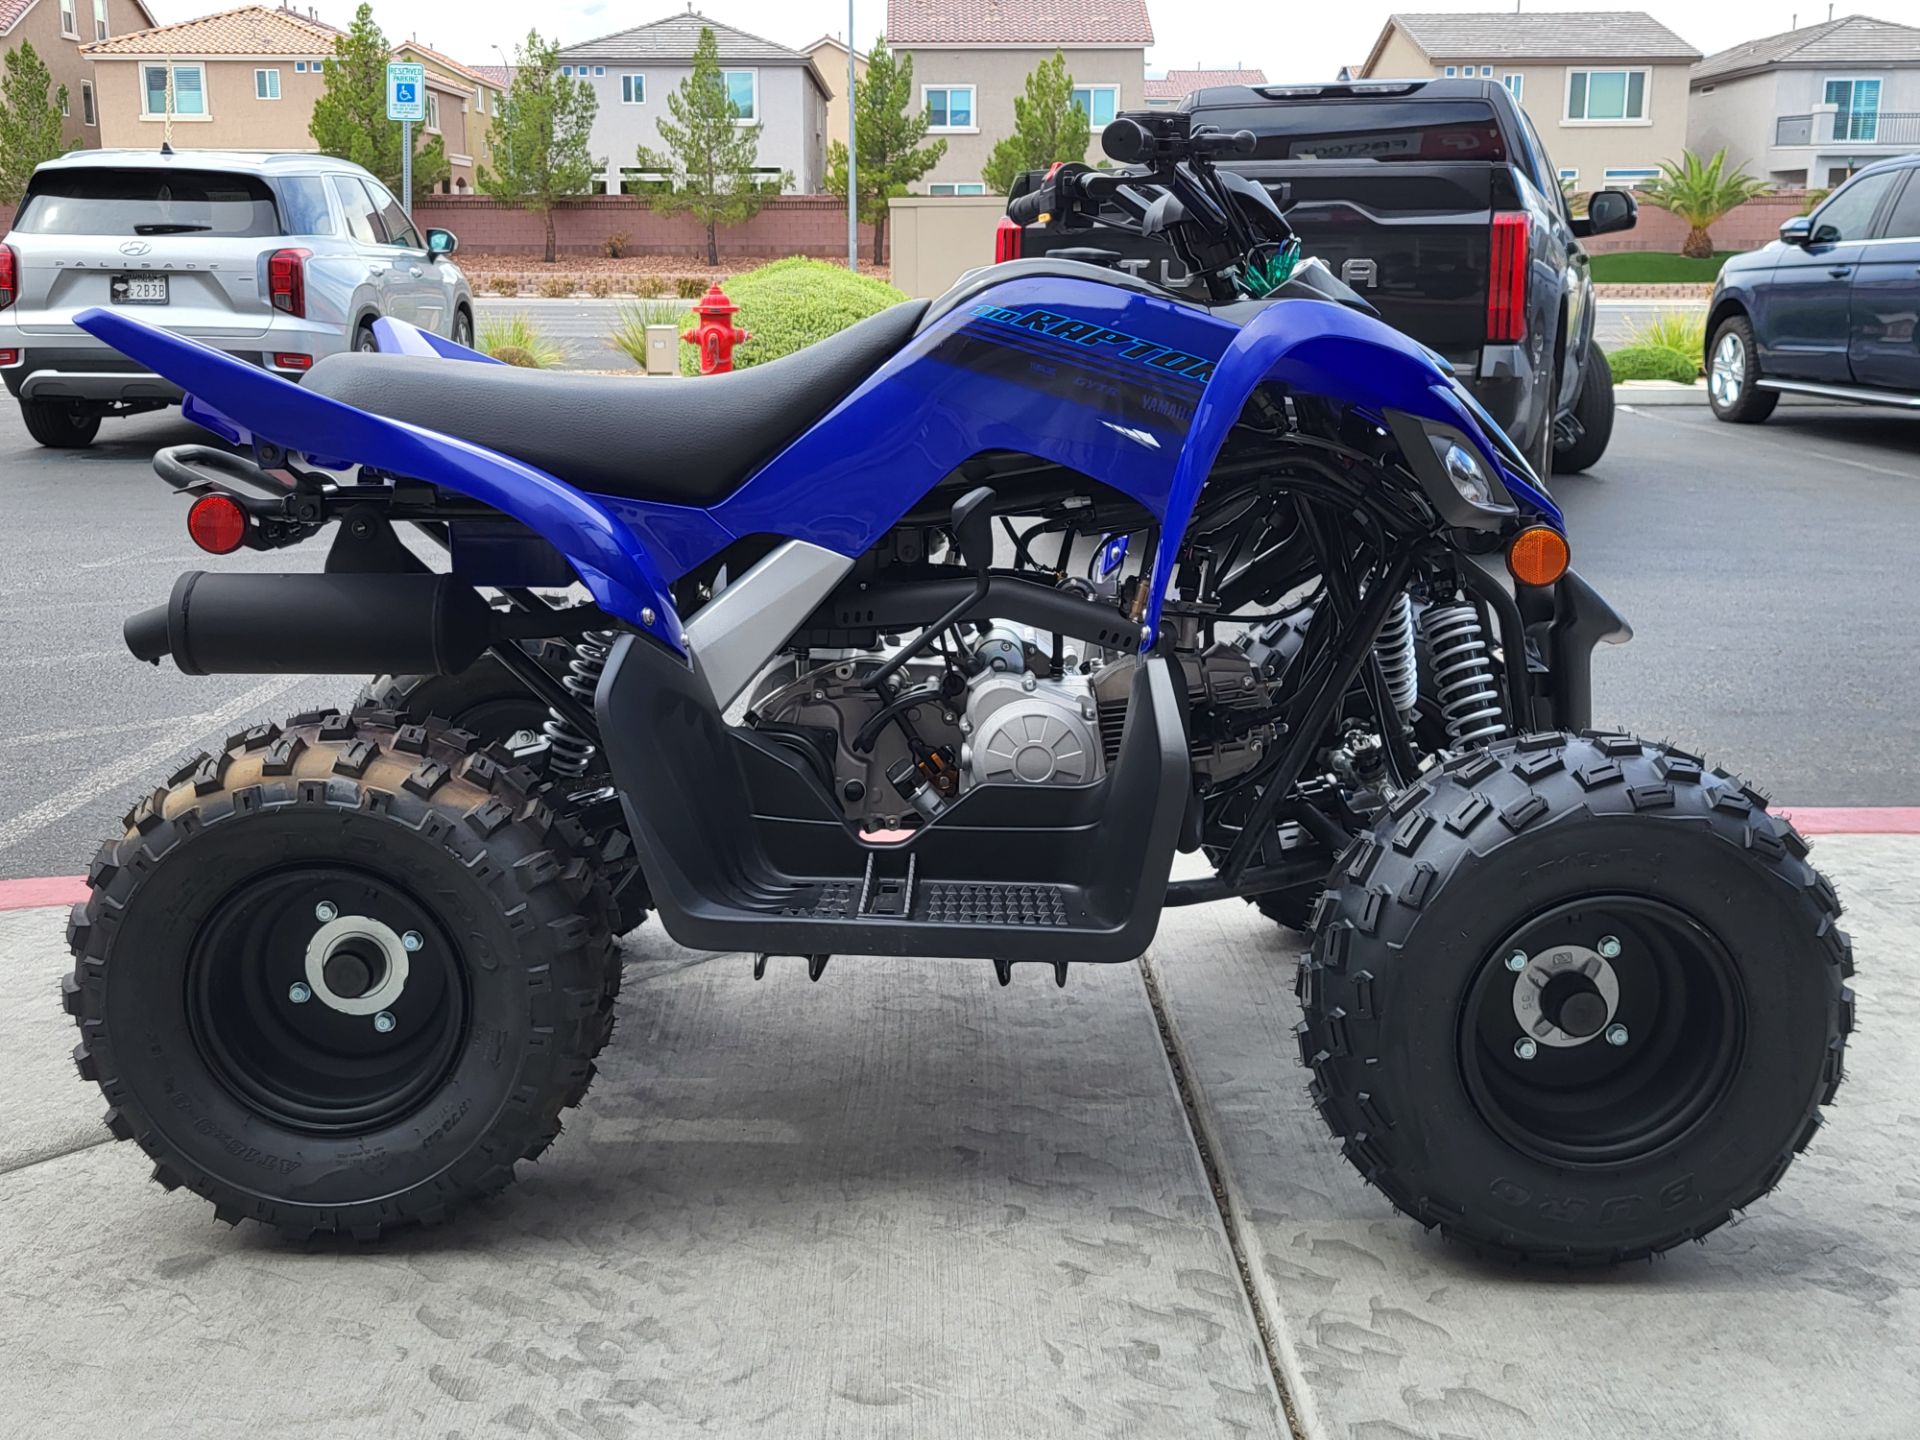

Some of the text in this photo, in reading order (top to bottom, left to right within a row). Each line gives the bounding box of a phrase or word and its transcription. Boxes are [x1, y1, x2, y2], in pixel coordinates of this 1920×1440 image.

[389, 67, 422, 76] RESERVED
[393, 75, 418, 83] PARKING
[55, 260, 220, 270] PALISADE
[1017, 309, 1217, 384] RAPTOR
